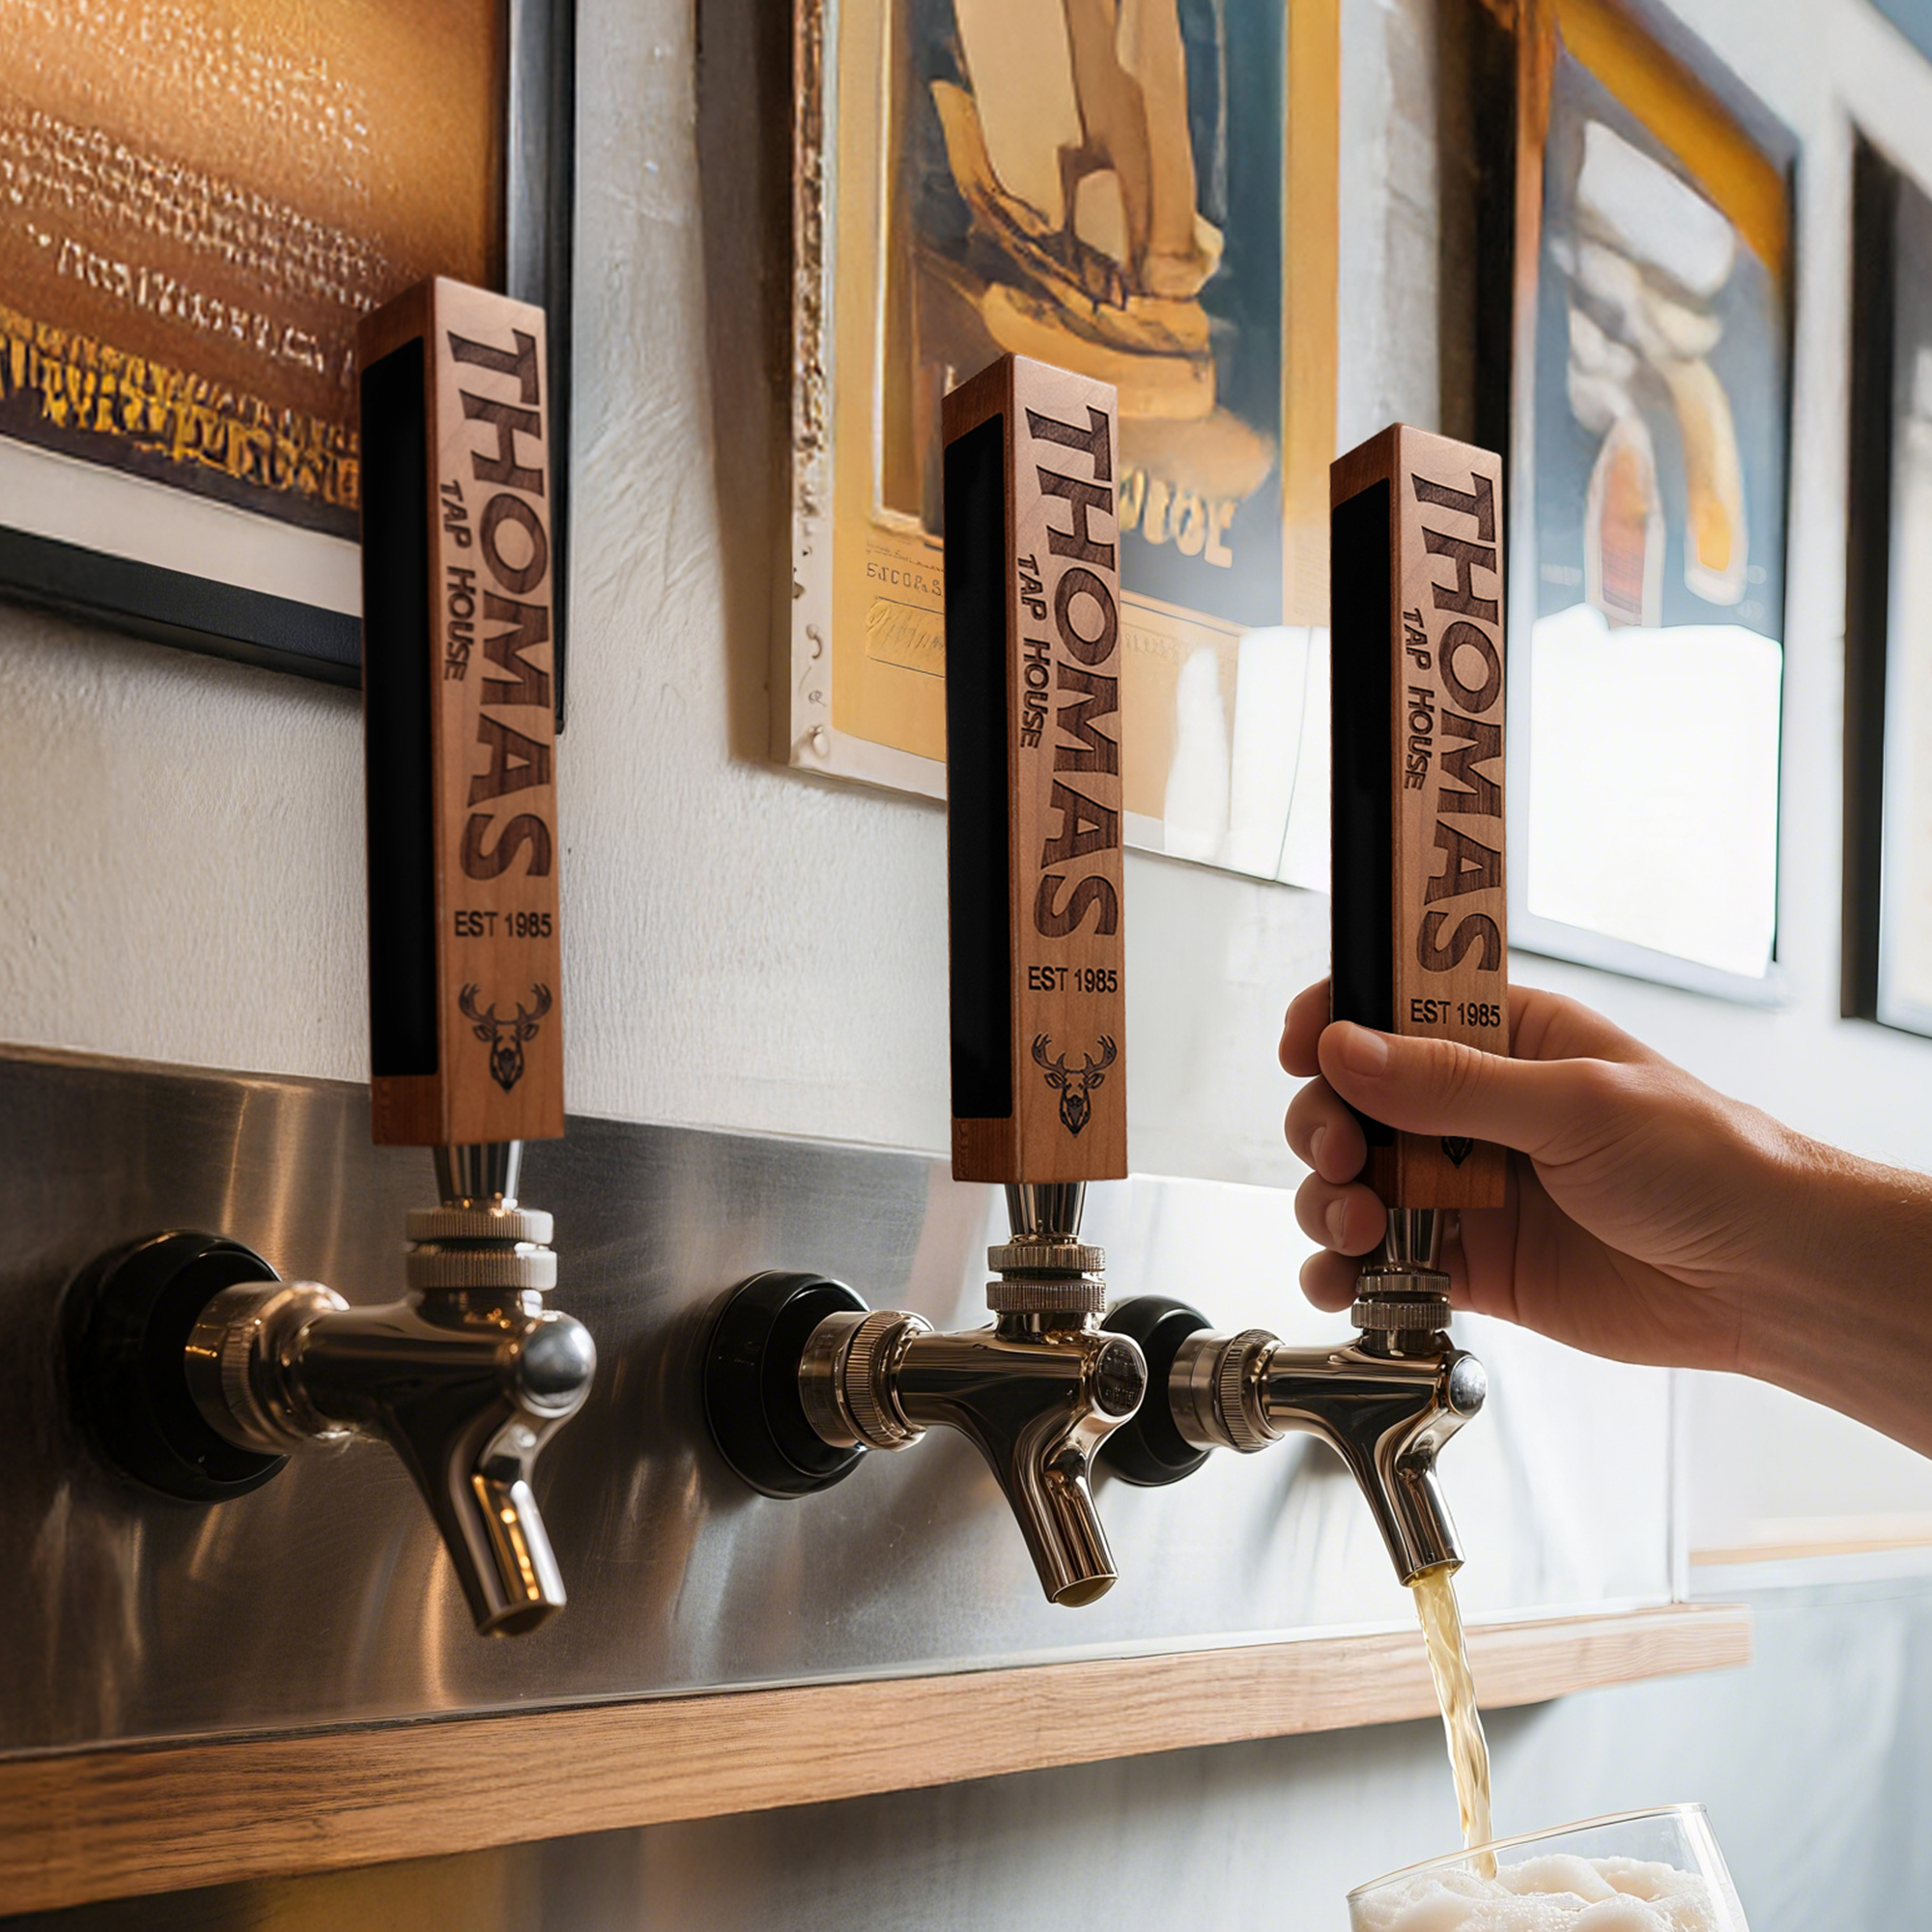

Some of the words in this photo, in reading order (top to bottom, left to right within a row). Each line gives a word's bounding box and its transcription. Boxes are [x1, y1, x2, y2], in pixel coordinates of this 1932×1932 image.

[440, 479, 472, 549] TAP
[444, 565, 476, 680] HOUSE
[446, 327, 552, 880] THOMAS
[1017, 554, 1047, 621] TAP
[1025, 405, 1119, 938] THOMAS
[1403, 608, 1433, 670] TAP
[1020, 637, 1050, 749] HOUSE
[1410, 471, 1502, 973] THOMAS
[1404, 685, 1435, 790] HOUSE
[454, 911, 497, 937] EST
[504, 912, 552, 938] 1985
[1028, 966, 1067, 991] EST
[1074, 969, 1118, 993] 1985
[1410, 999, 1450, 1024] EST
[1457, 1002, 1501, 1028] 1985
